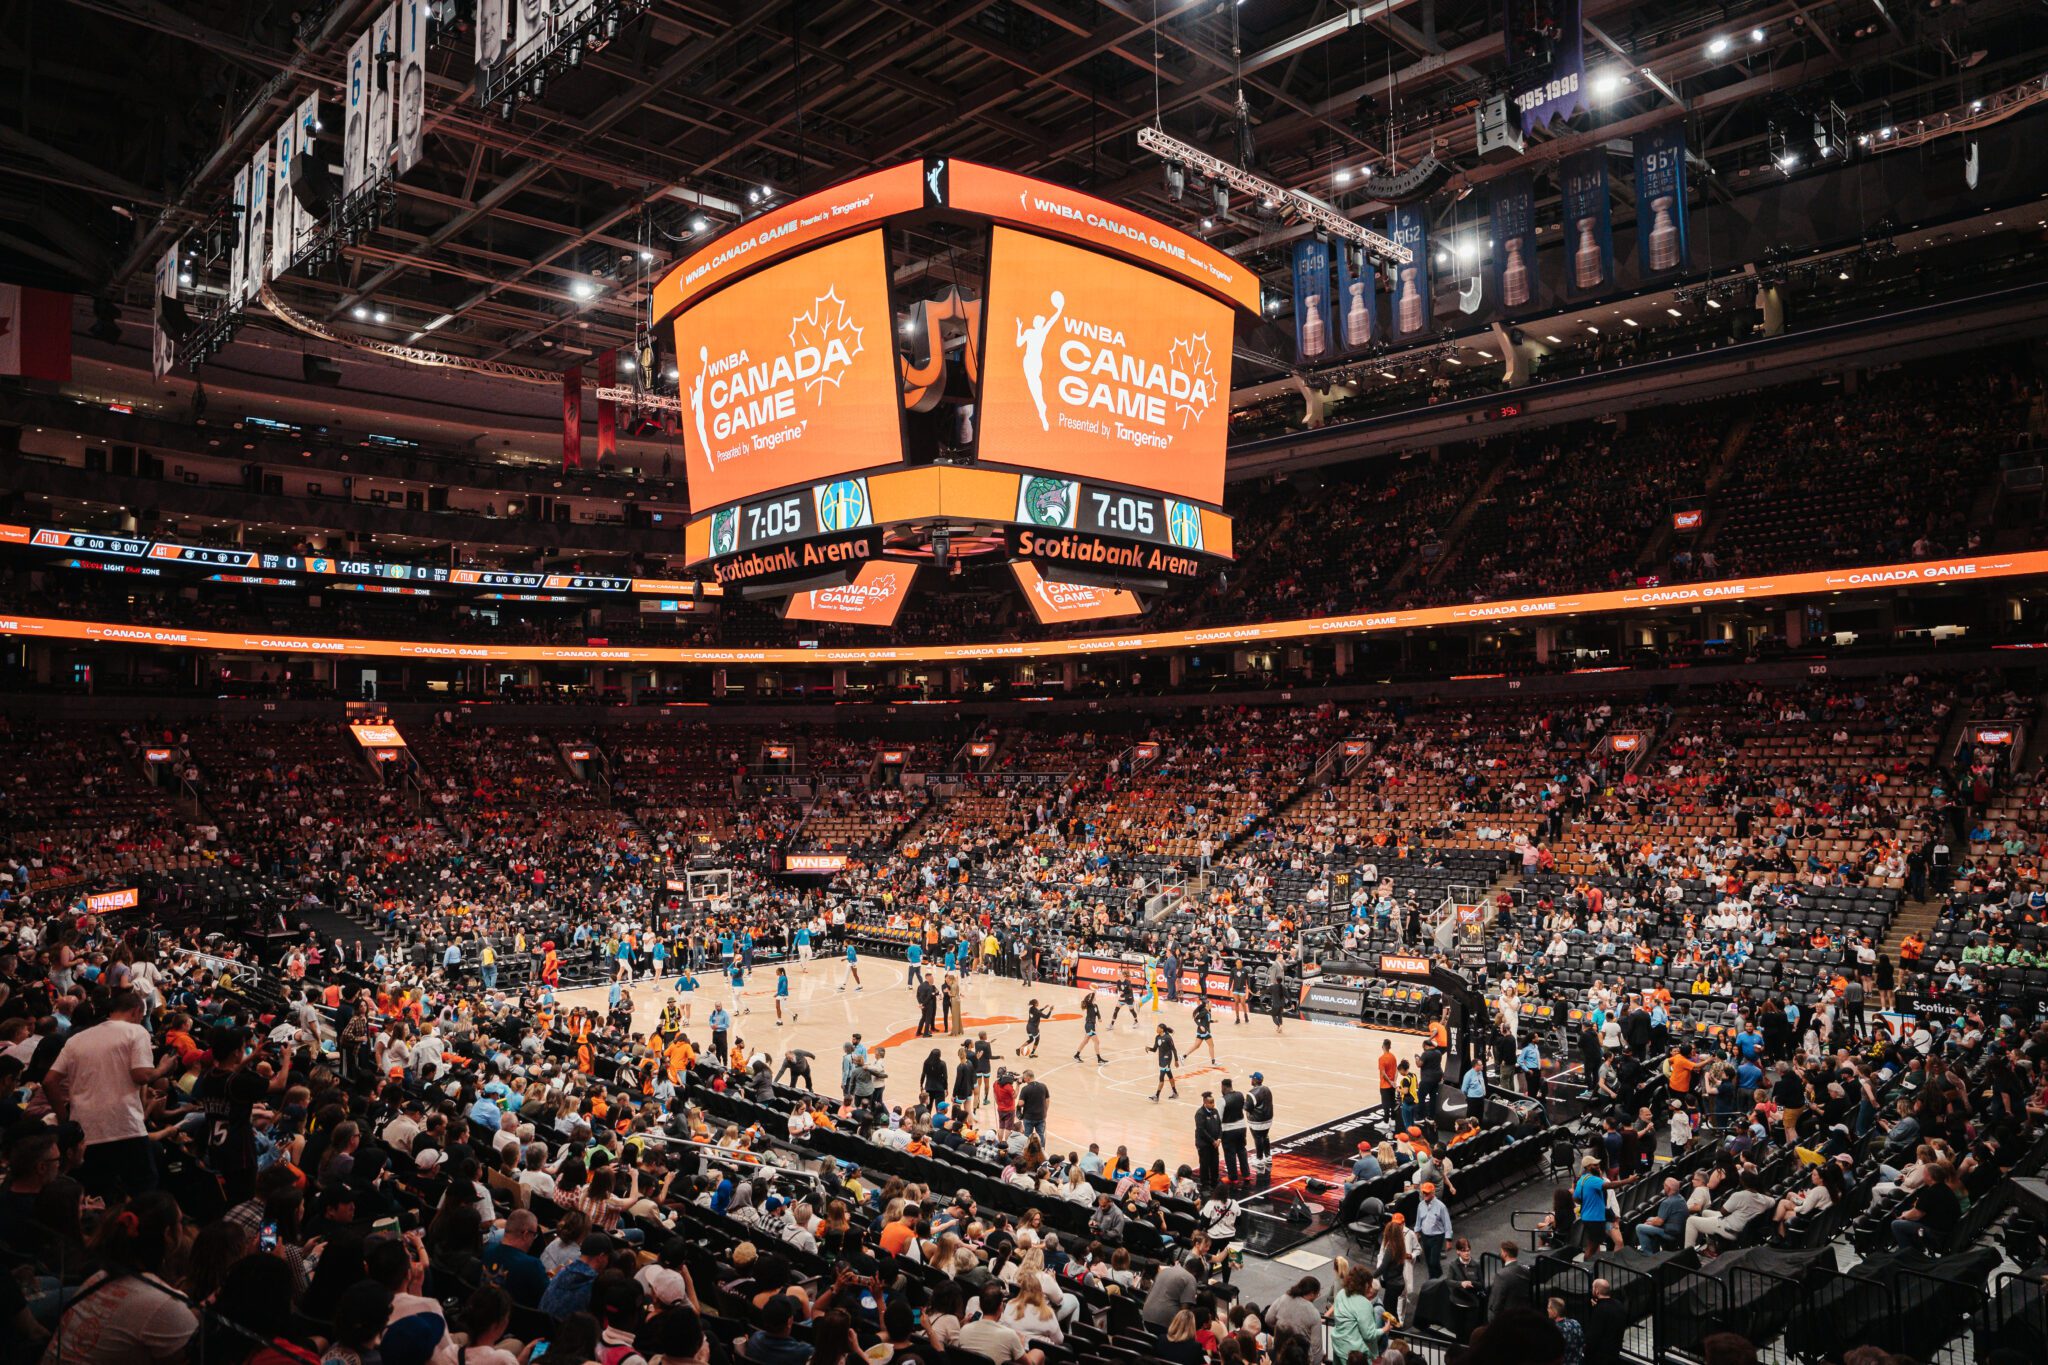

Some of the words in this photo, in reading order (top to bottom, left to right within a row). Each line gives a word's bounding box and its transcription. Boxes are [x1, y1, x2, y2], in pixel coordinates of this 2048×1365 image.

[281, 137, 290, 179] 9
[254, 163, 265, 209] 10
[1034, 198, 1084, 222] WNBA
[1086, 214, 1147, 244] CANADA
[1149, 236, 1185, 260] GAME
[686, 262, 711, 285] WNBA
[712, 240, 757, 269] CANADA
[758, 220, 798, 245] GAME
[831, 197, 870, 217] Tangerine
[1064, 316, 1126, 347] WNBA
[708, 350, 749, 378] WNBA
[710, 338, 852, 409] CANADA
[1060, 340, 1209, 408] CANADA
[1058, 376, 1167, 426] GAME
[713, 388, 796, 440] GAME
[1059, 412, 1099, 434] Presented
[1102, 422, 1111, 438] by
[1114, 422, 1167, 449] Tangerine
[717, 444, 742, 463] Presented
[742, 442, 750, 456] by
[751, 426, 802, 451] Tangerine
[748, 498, 800, 541] 7:05
[1092, 492, 1154, 535] 7:05
[90, 540, 104, 549] 0/0
[124, 544, 138, 553] 0/0
[714, 546, 799, 584] Scotiabank
[804, 539, 870, 566] Arena
[1018, 531, 1144, 568] Scotiabank
[1148, 549, 1198, 577] Arena
[104, 564, 125, 572] LIGHT
[142, 568, 160, 576] ZONE
[287, 557, 297, 569] 0
[341, 561, 370, 574] 7:05
[418, 568, 427, 578] 0
[1849, 570, 1919, 584] CANADA
[1924, 565, 1976, 577] GAME
[524, 577, 535, 585] 0/0
[821, 593, 865, 605] GAME
[1053, 591, 1094, 603] GAME
[1642, 590, 1699, 602] CANADA
[1703, 586, 1745, 597] GAME
[1469, 606, 1517, 617] CANADA
[1521, 603, 1557, 612] GAME
[1322, 620, 1363, 630] CANADA
[1366, 617, 1397, 626] GAME
[104, 629, 152, 639] CANADA
[155, 633, 187, 642] GAME
[261, 640, 309, 649] CANADA
[415, 647, 456, 655] CANADA
[1809, 666, 1827, 674] 120
[1509, 681, 1521, 689] 119
[792, 858, 842, 868] WNBA
[91, 892, 134, 911] WNBA
[1092, 966, 1118, 976] VISIT
[1385, 959, 1425, 971] WNBA
[1311, 994, 1357, 1006] WNBA.COM
[1450, 1027, 1458, 1052] WNBA
